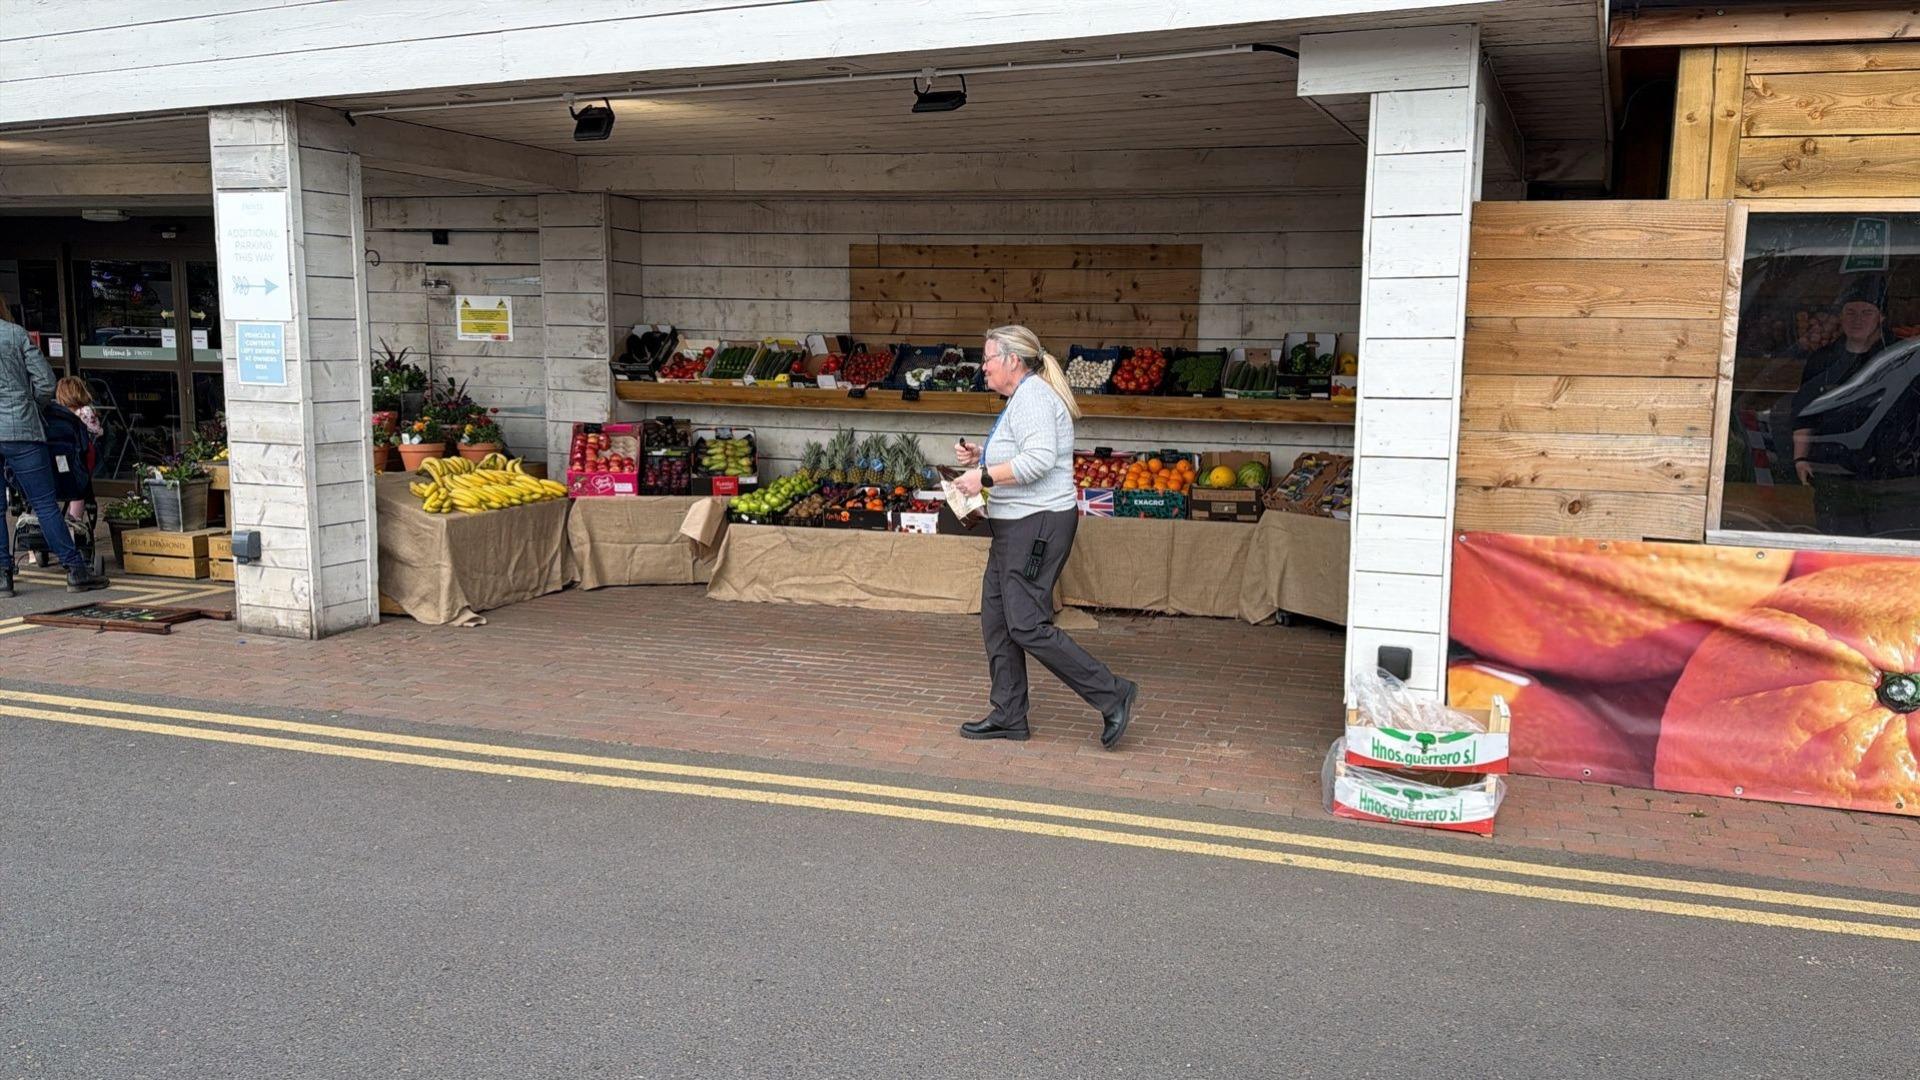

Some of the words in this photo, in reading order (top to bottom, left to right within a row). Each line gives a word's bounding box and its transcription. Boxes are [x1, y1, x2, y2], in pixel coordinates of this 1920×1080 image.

[227, 228, 280, 238] ADDITIONAL
[234, 240, 272, 250] PARKING
[233, 252, 254, 262] THIS
[255, 252, 275, 262] WAY
